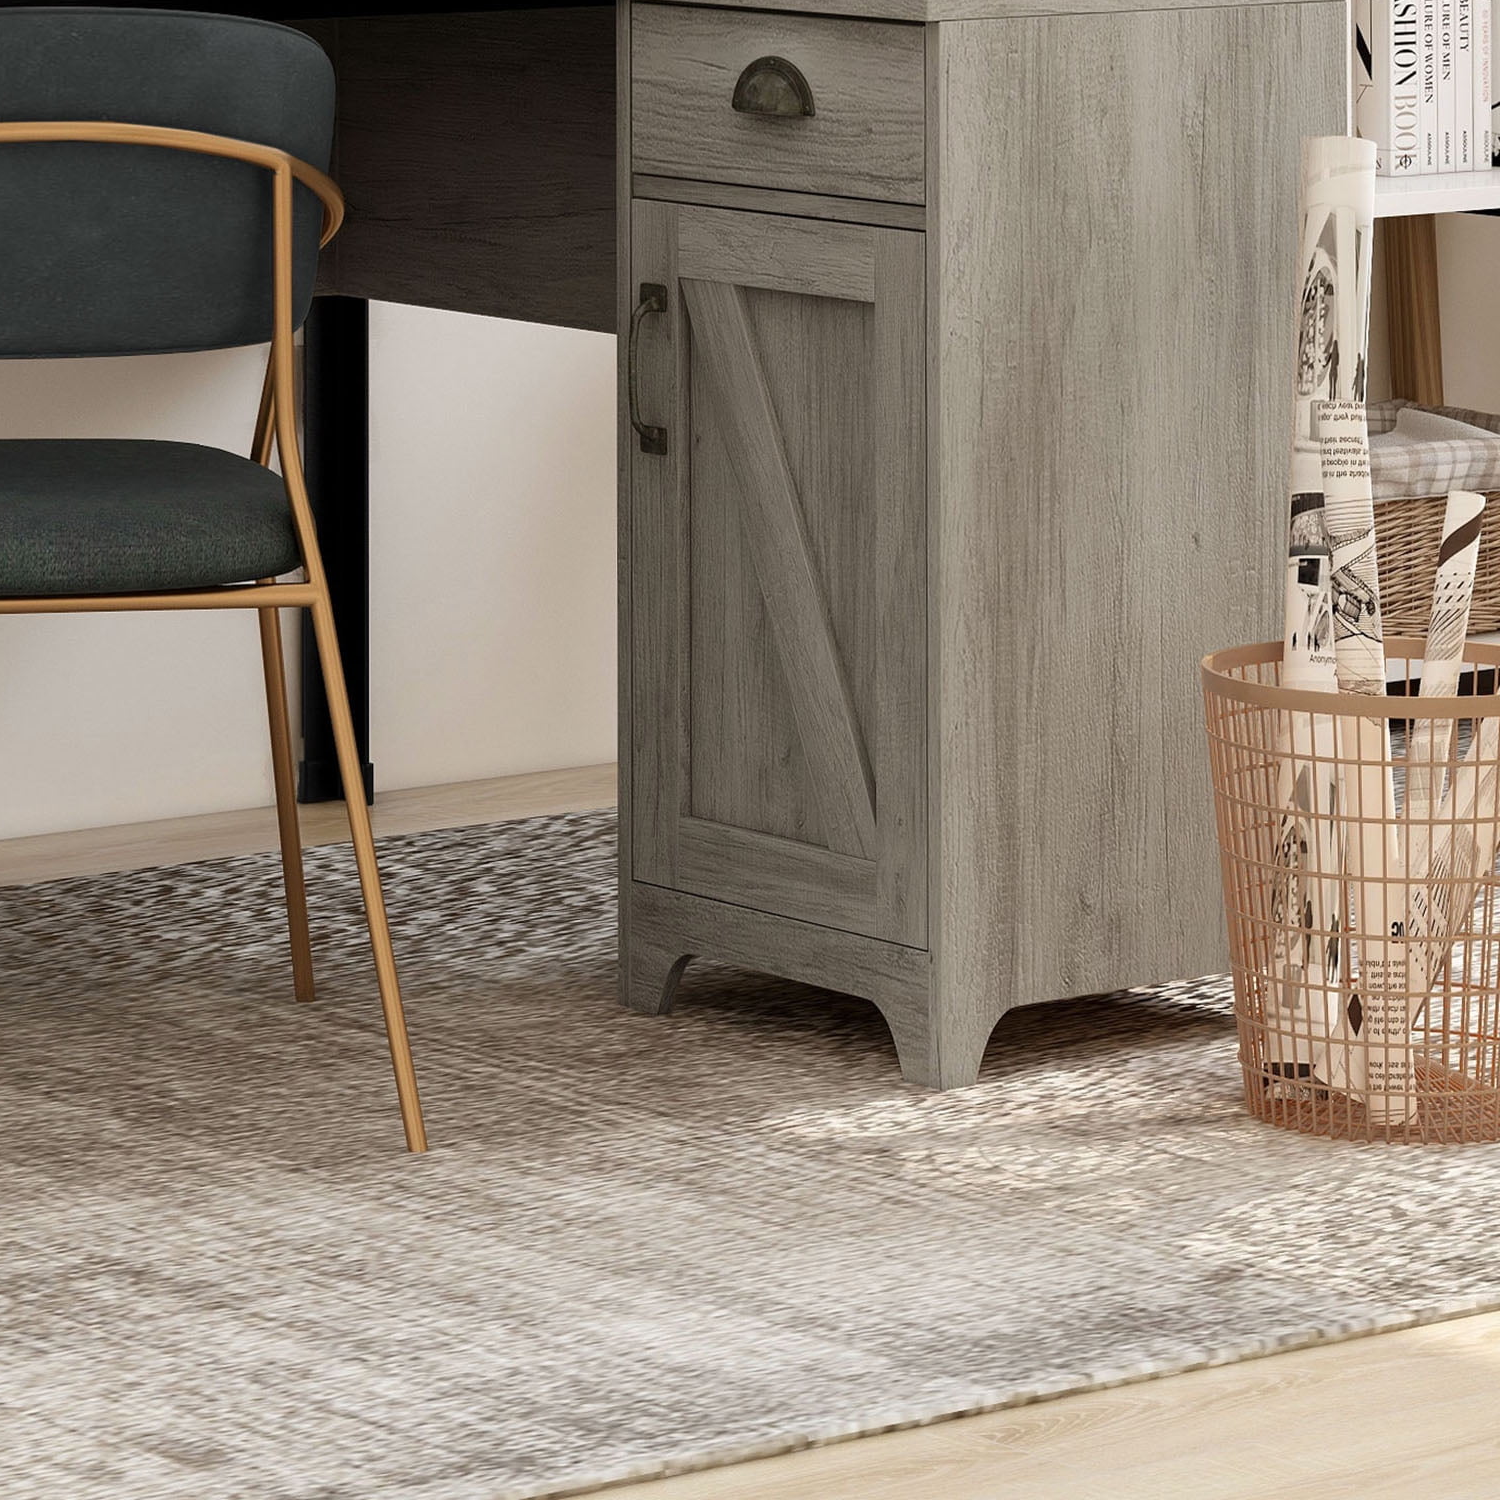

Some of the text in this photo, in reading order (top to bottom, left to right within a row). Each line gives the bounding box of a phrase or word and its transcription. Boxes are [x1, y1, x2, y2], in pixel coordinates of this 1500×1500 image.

[1424, 33, 1434, 50] OF
[1442, 32, 1451, 49] OF
[1442, 52, 1451, 80] MEN
[1424, 52, 1434, 103] WOMEN
[1394, 95, 1417, 170] BOOK
[1309, 654, 1337, 667] Anonymo
